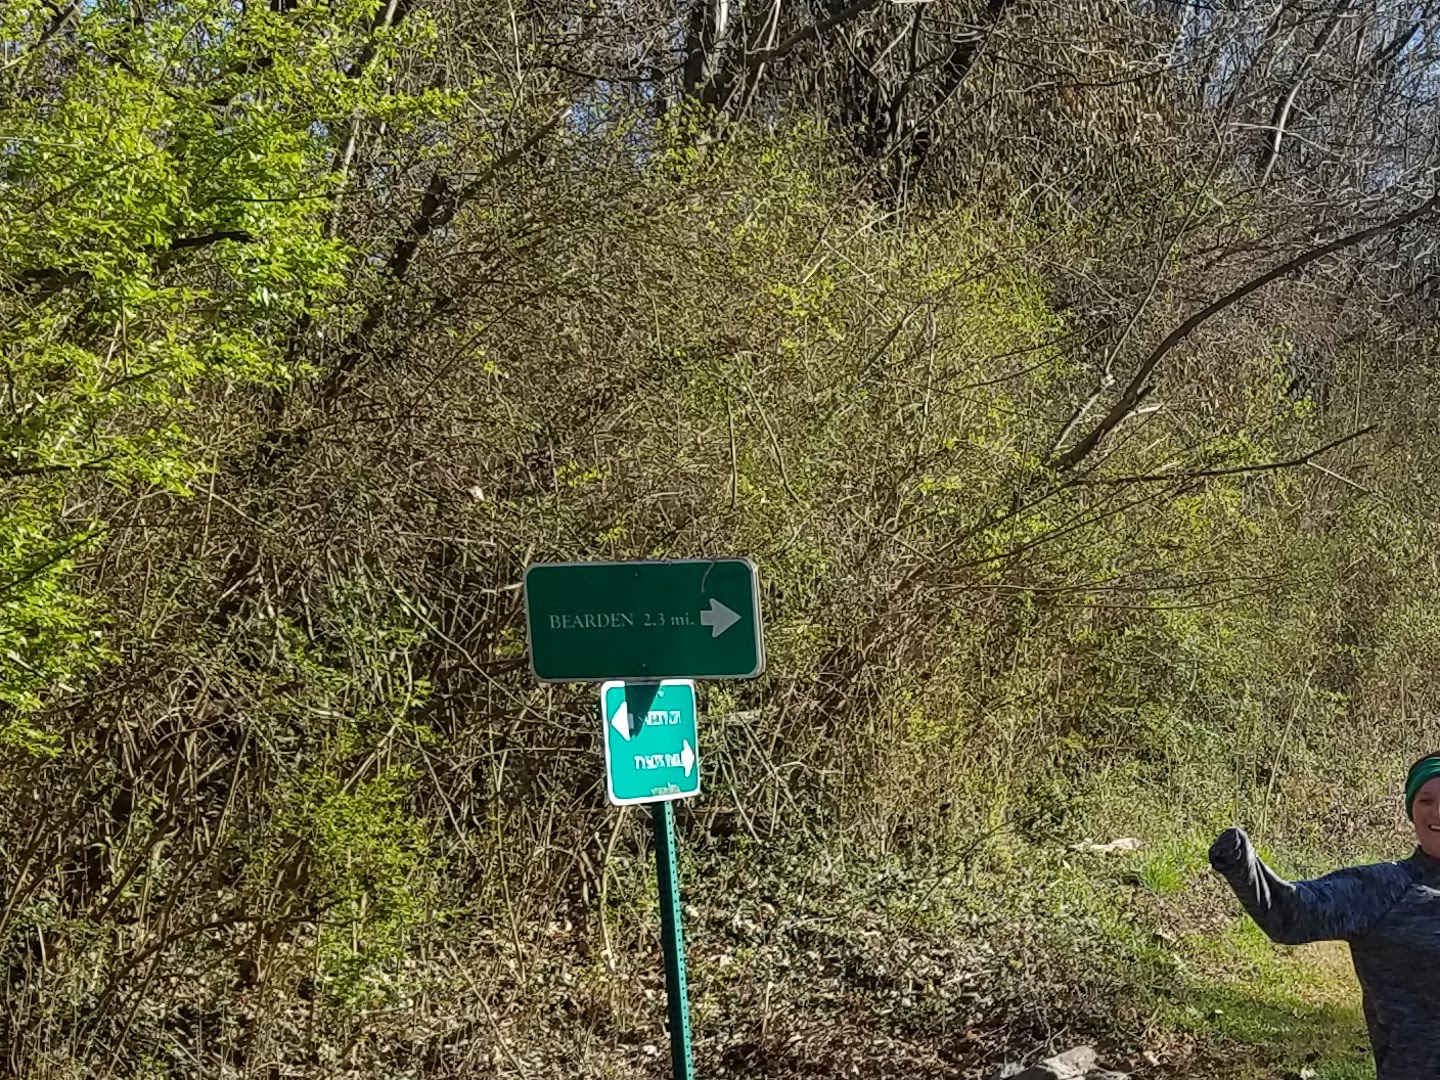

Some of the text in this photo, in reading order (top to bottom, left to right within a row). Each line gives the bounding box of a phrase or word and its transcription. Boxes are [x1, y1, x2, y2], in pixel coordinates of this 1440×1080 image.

[549, 611, 695, 629] BEARDEN 2.3 mi.
